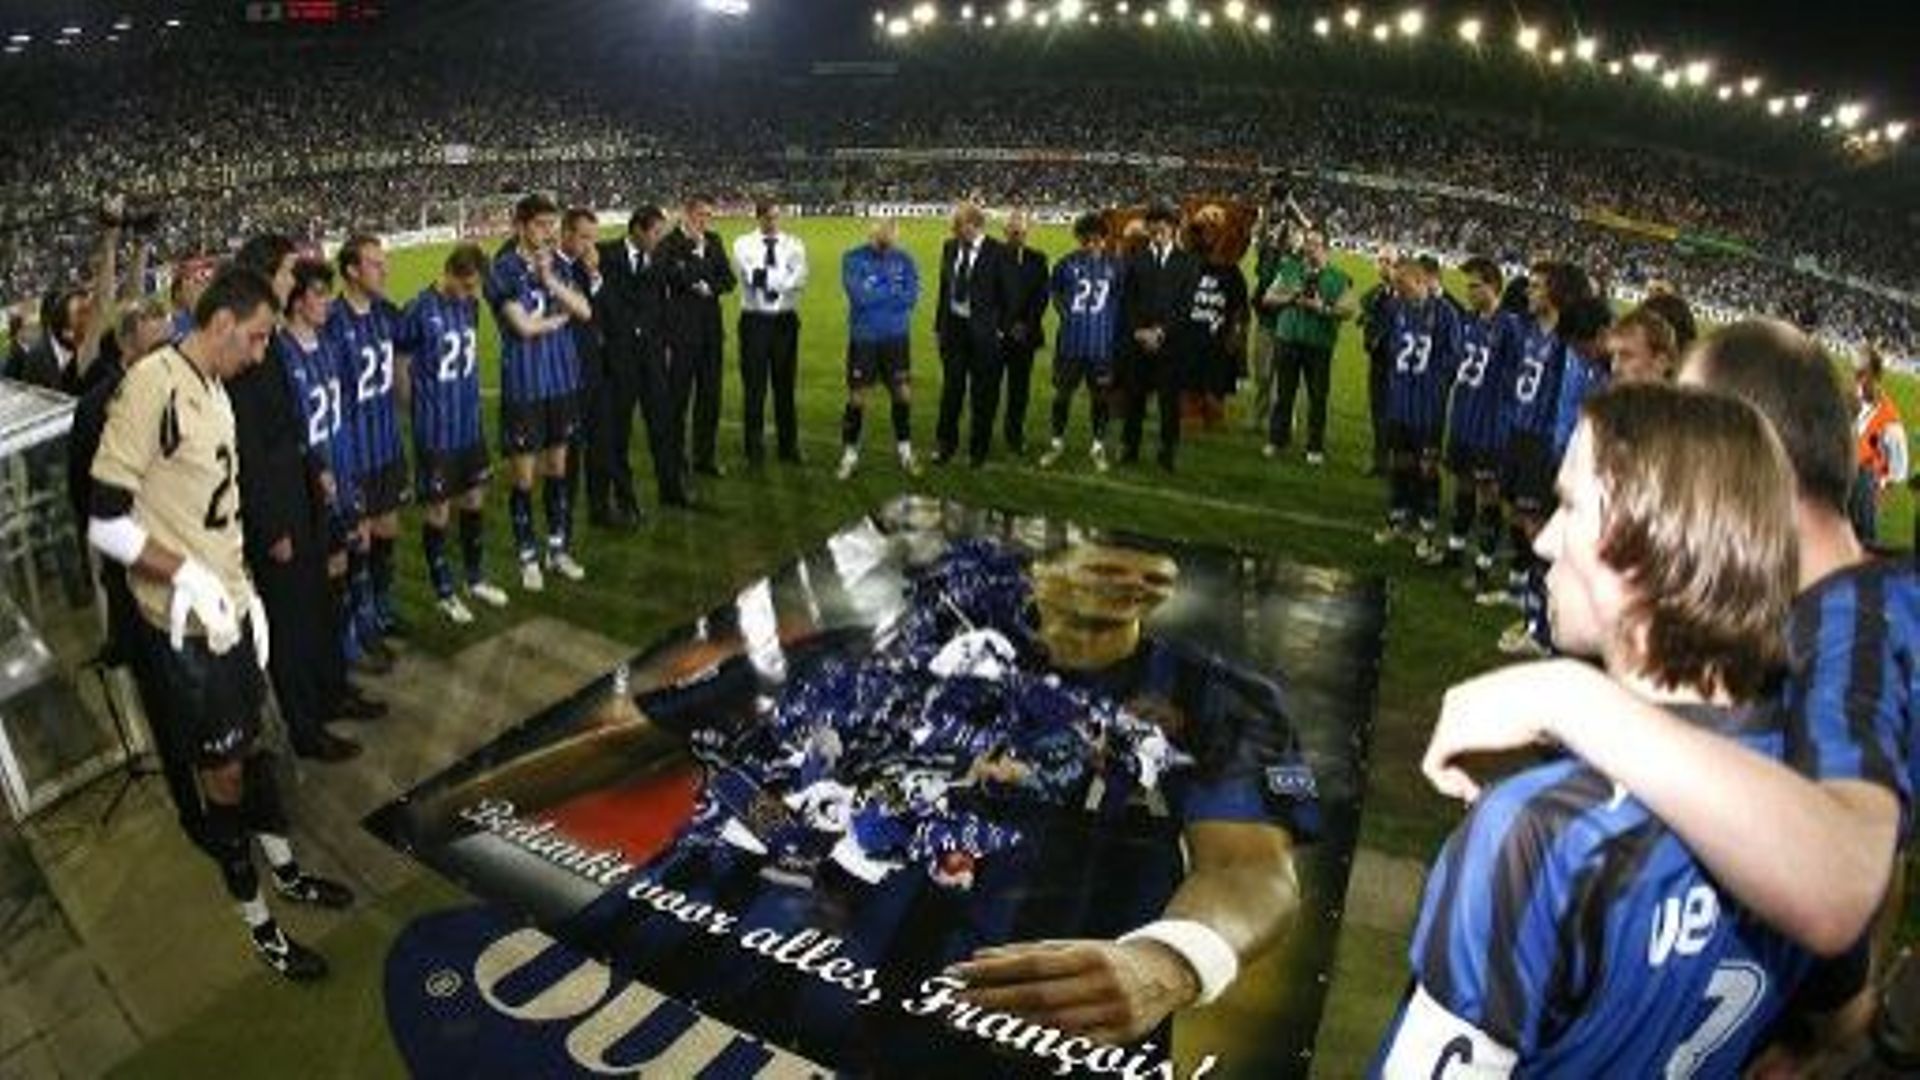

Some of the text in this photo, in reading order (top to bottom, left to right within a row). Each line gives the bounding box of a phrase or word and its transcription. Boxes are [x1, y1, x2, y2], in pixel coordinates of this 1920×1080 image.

[1071, 279, 1110, 314] 23
[358, 340, 394, 401] 23
[438, 328, 475, 382] 23
[1397, 331, 1432, 374] 23
[204, 443, 240, 529] 2
[460, 799, 636, 887] Bedankt
[628, 881, 738, 934] voor
[740, 928, 881, 1004] alles,
